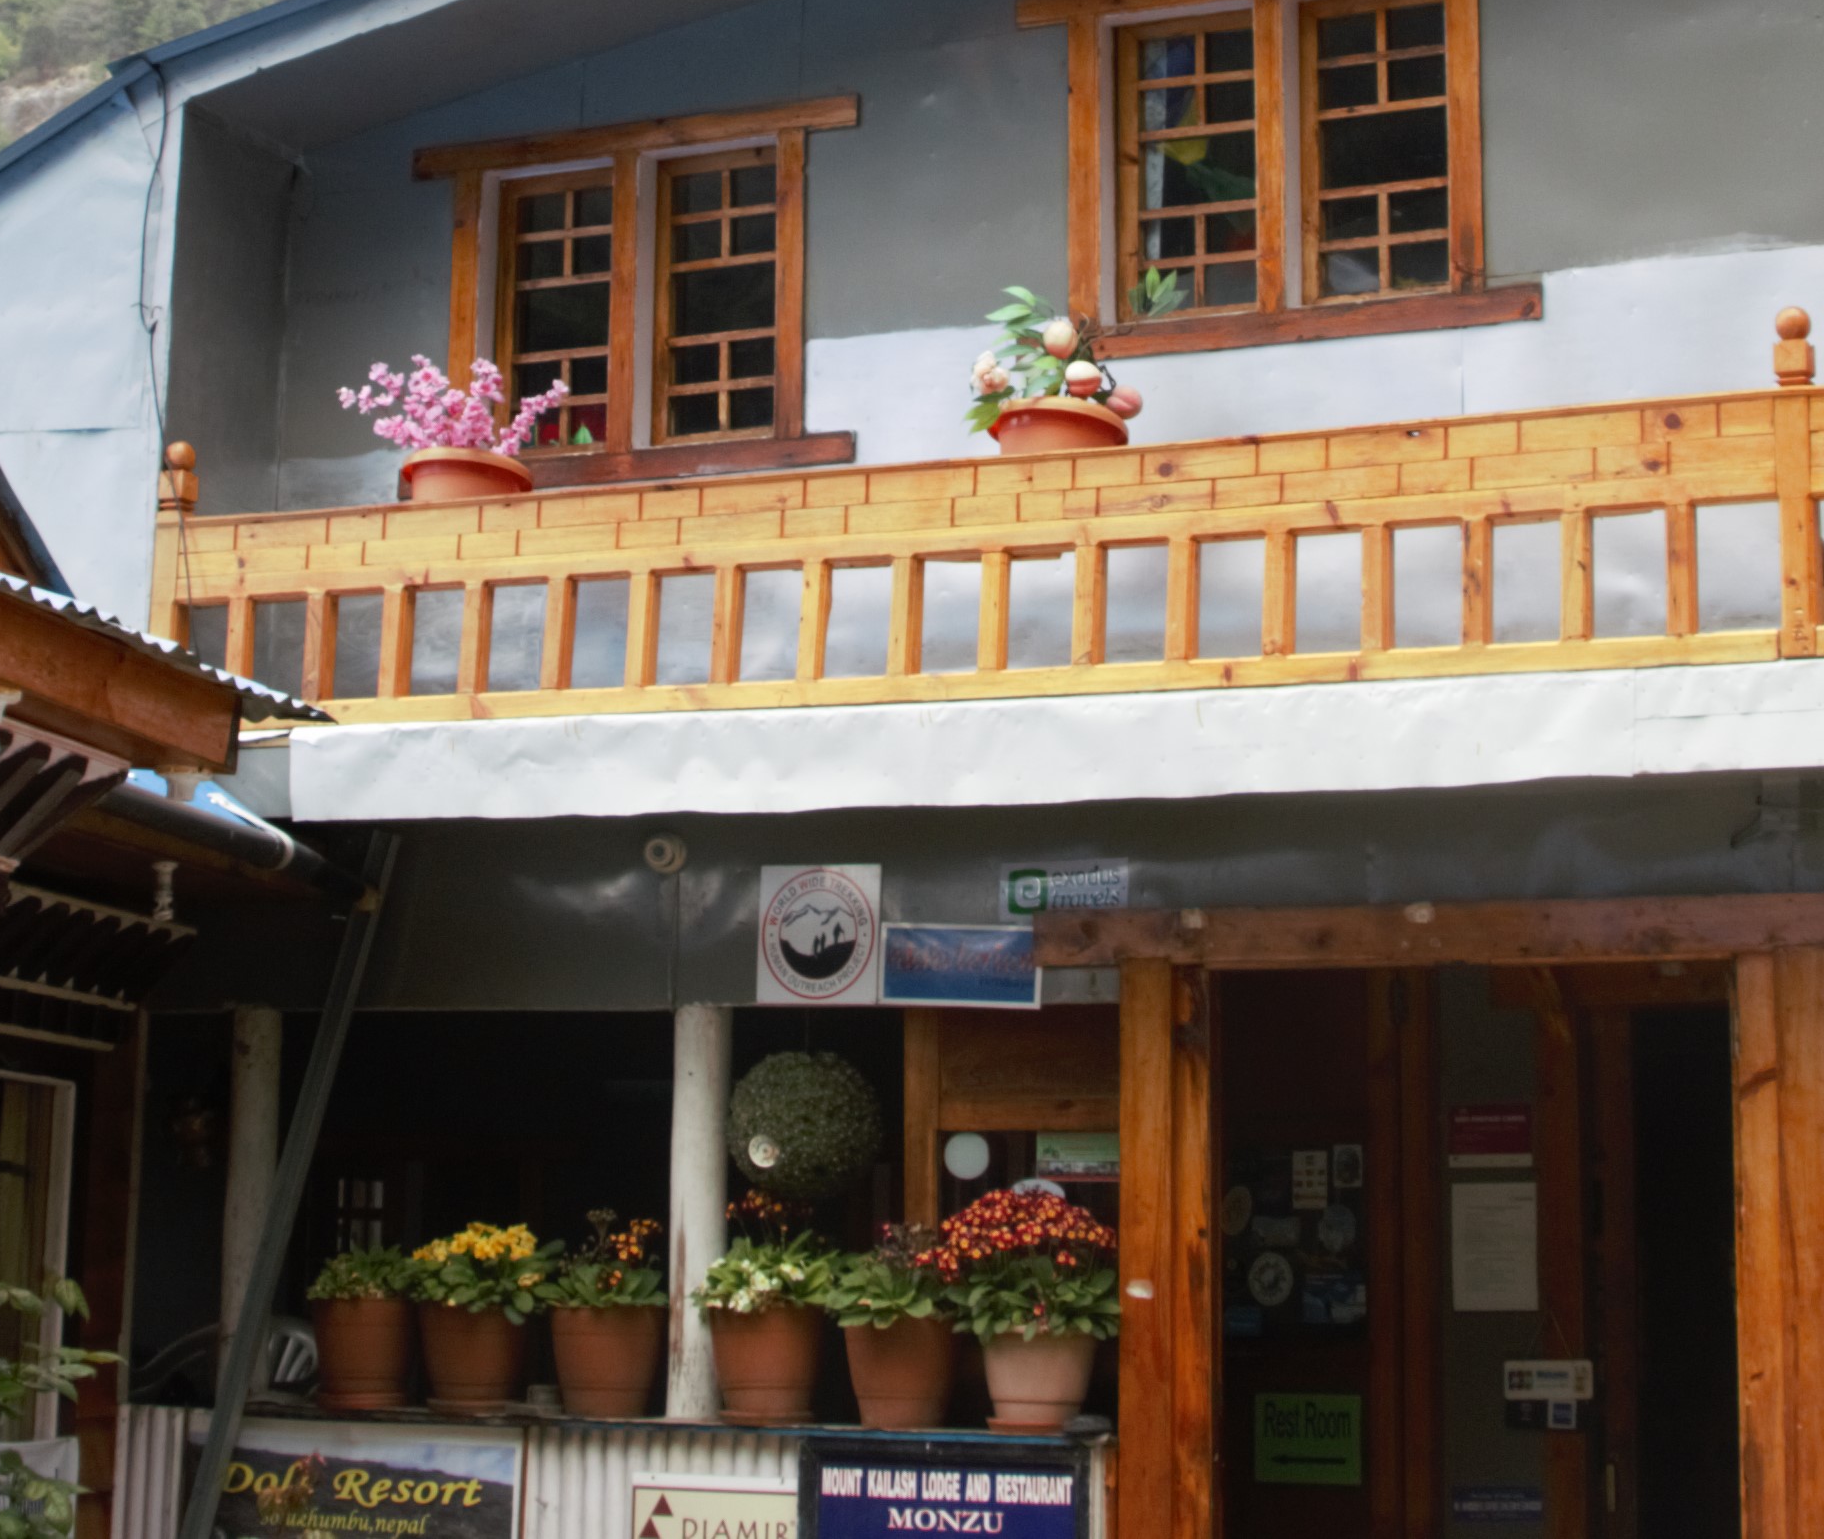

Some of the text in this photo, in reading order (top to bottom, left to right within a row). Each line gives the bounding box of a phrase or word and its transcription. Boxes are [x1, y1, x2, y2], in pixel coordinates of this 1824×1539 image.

[1050, 865, 1121, 887] exodus
[768, 876, 868, 927] WORLD WIDE TREKKING
[1050, 887, 1121, 909] travels
[769, 942, 789, 977] HUMAN
[787, 974, 836, 994] OUTREACH
[837, 942, 866, 985] PROJECT
[1263, 1401, 1353, 1440] Rest Room
[222, 1459, 483, 1509] Dol Resort
[821, 1466, 1075, 1507] MOUNT KAILASH LODGE AND RESTAURANT
[260, 1508, 430, 1537] Soukhumbu,nepal
[887, 1506, 1006, 1536] MONZU
